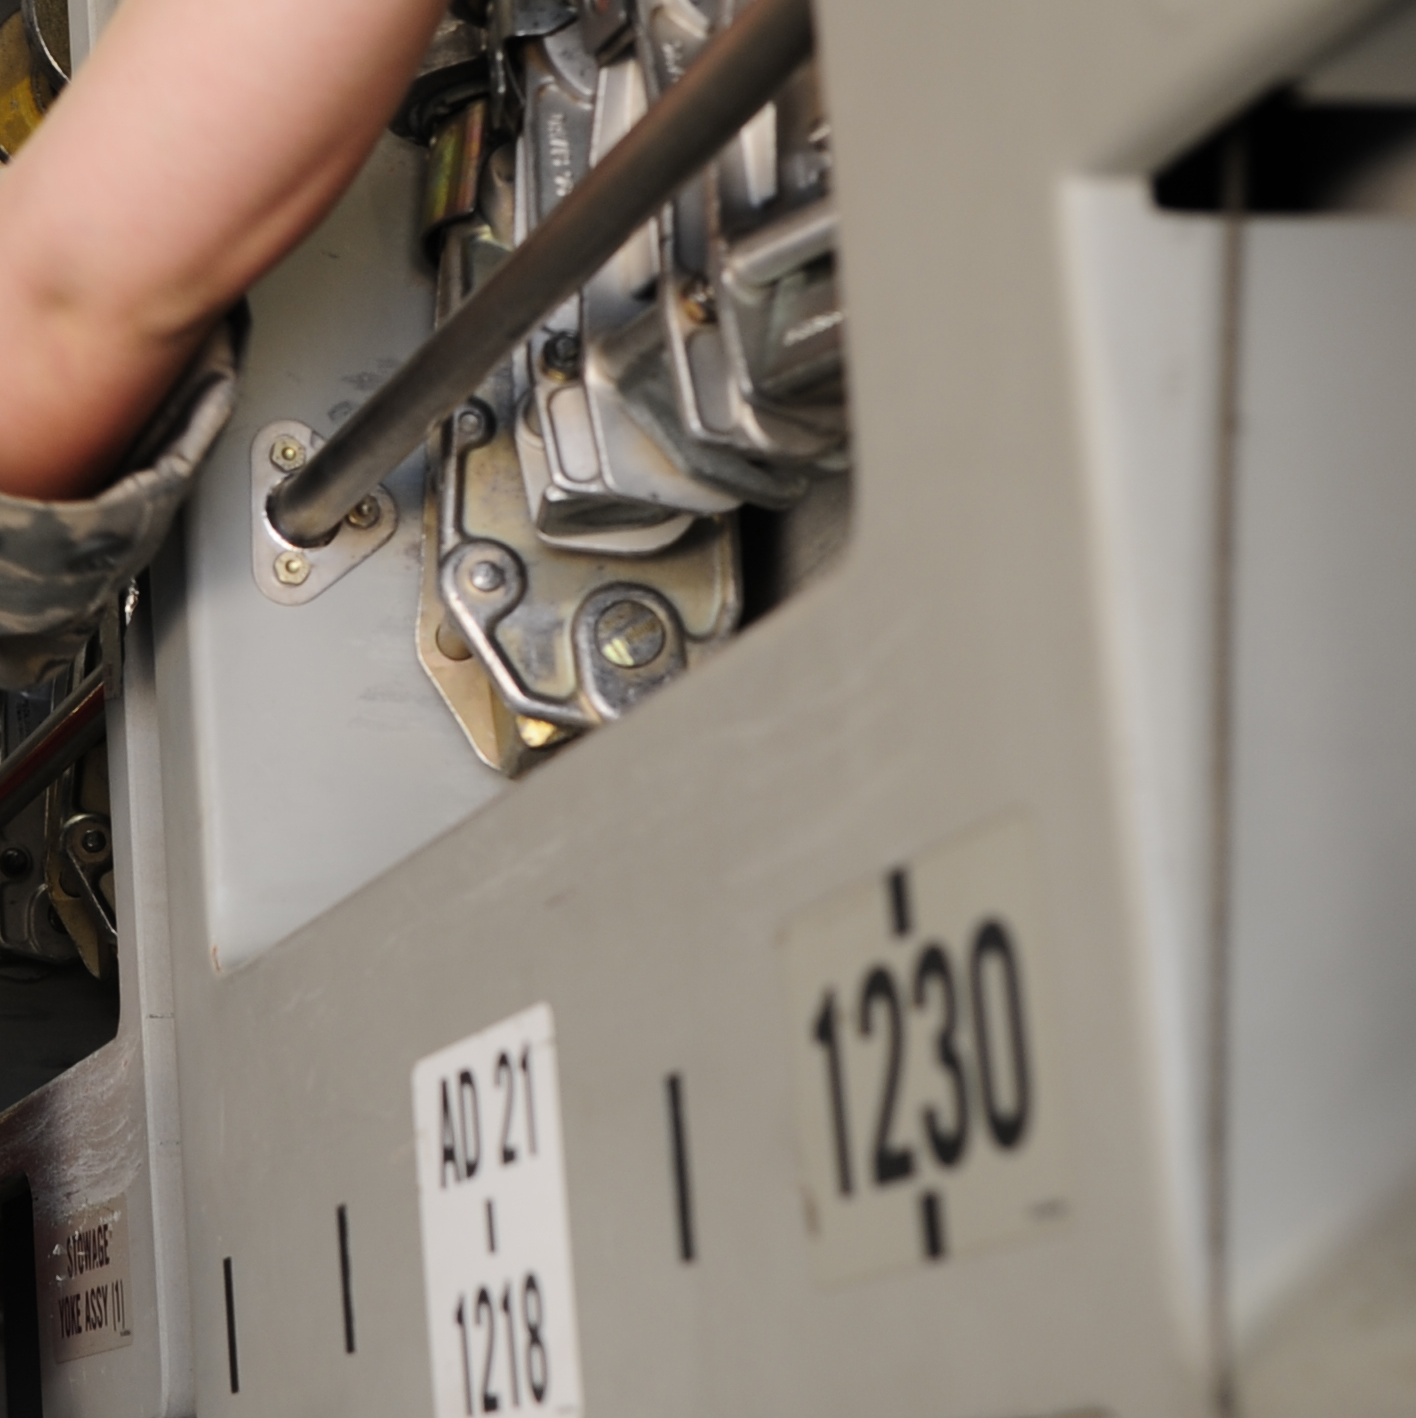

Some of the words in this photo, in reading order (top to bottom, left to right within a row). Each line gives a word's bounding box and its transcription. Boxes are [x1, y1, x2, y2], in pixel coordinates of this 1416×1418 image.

[437, 1067, 481, 1189] AD
[493, 1039, 538, 1166] 21
[813, 915, 1034, 1199] 1230
[58, 1292, 83, 1338] YOKE
[85, 1284, 108, 1332] ASSY
[66, 1223, 111, 1279] STOWAGE
[455, 1270, 549, 1418] 1218
